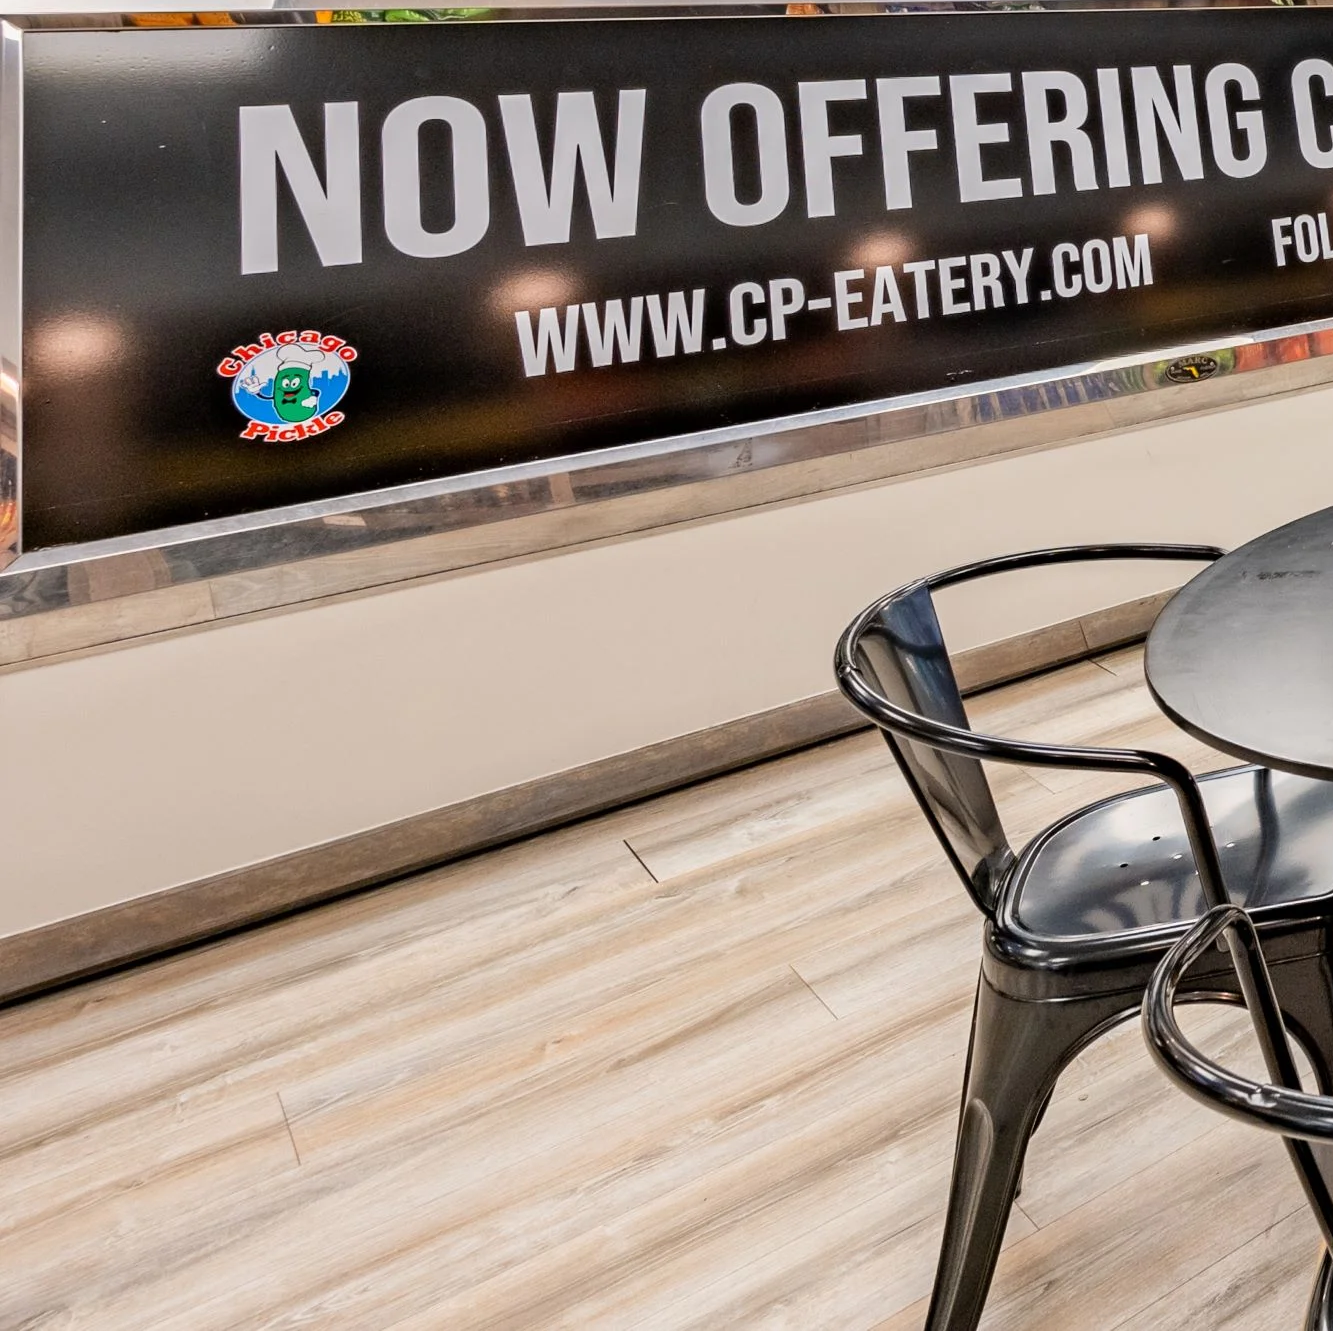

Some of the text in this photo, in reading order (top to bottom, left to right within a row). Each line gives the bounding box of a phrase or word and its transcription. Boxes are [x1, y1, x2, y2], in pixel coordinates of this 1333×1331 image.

[239, 86, 646, 275] NOW
[701, 63, 1267, 227] OFFERING
[217, 330, 358, 378] Chicago
[514, 234, 1154, 378] WWW.CP-EATERY.COM
[239, 411, 346, 442] Pickle
